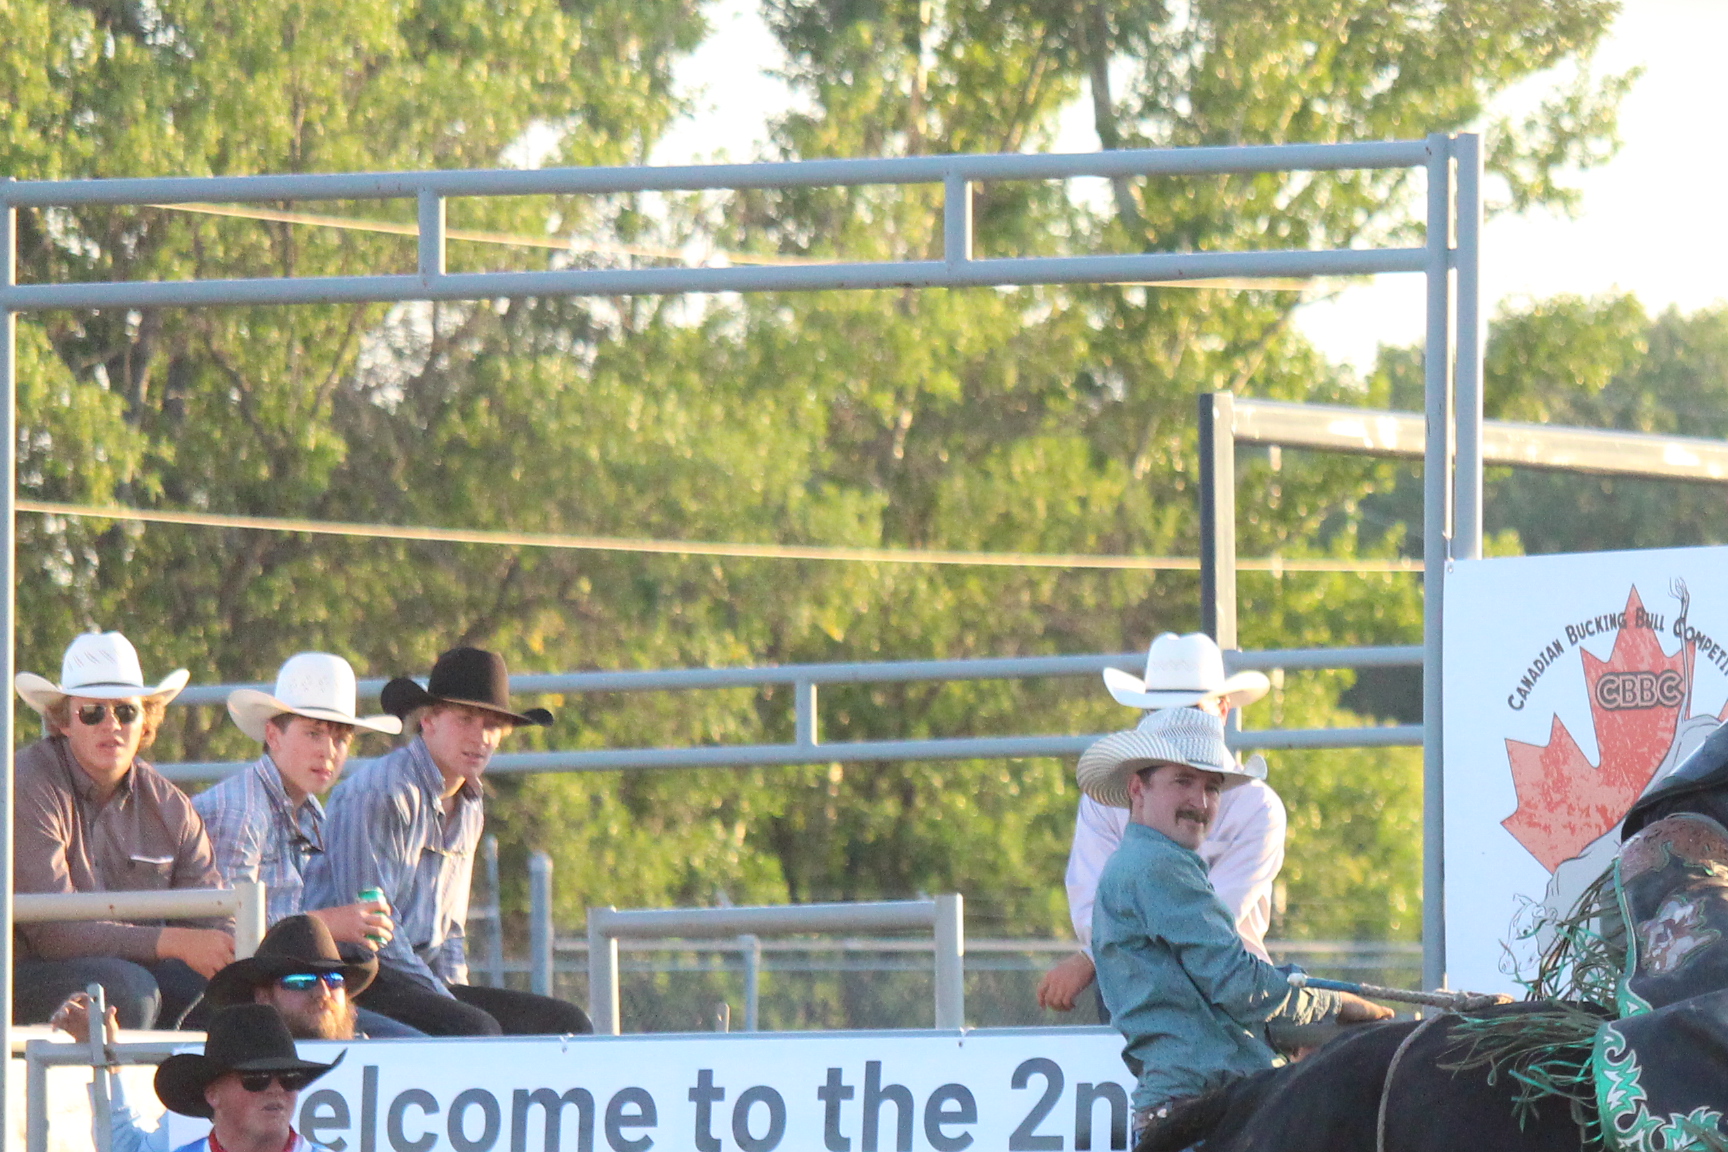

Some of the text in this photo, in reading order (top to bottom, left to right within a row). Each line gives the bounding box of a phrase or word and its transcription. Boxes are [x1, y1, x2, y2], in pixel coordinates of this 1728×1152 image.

[1507, 638, 1565, 711] CANADIAN
[1565, 612, 1628, 647] BUCKING
[1635, 607, 1665, 632] BULL
[1596, 669, 1685, 711] CBBC
[1009, 1057, 1132, 1152] 2n
